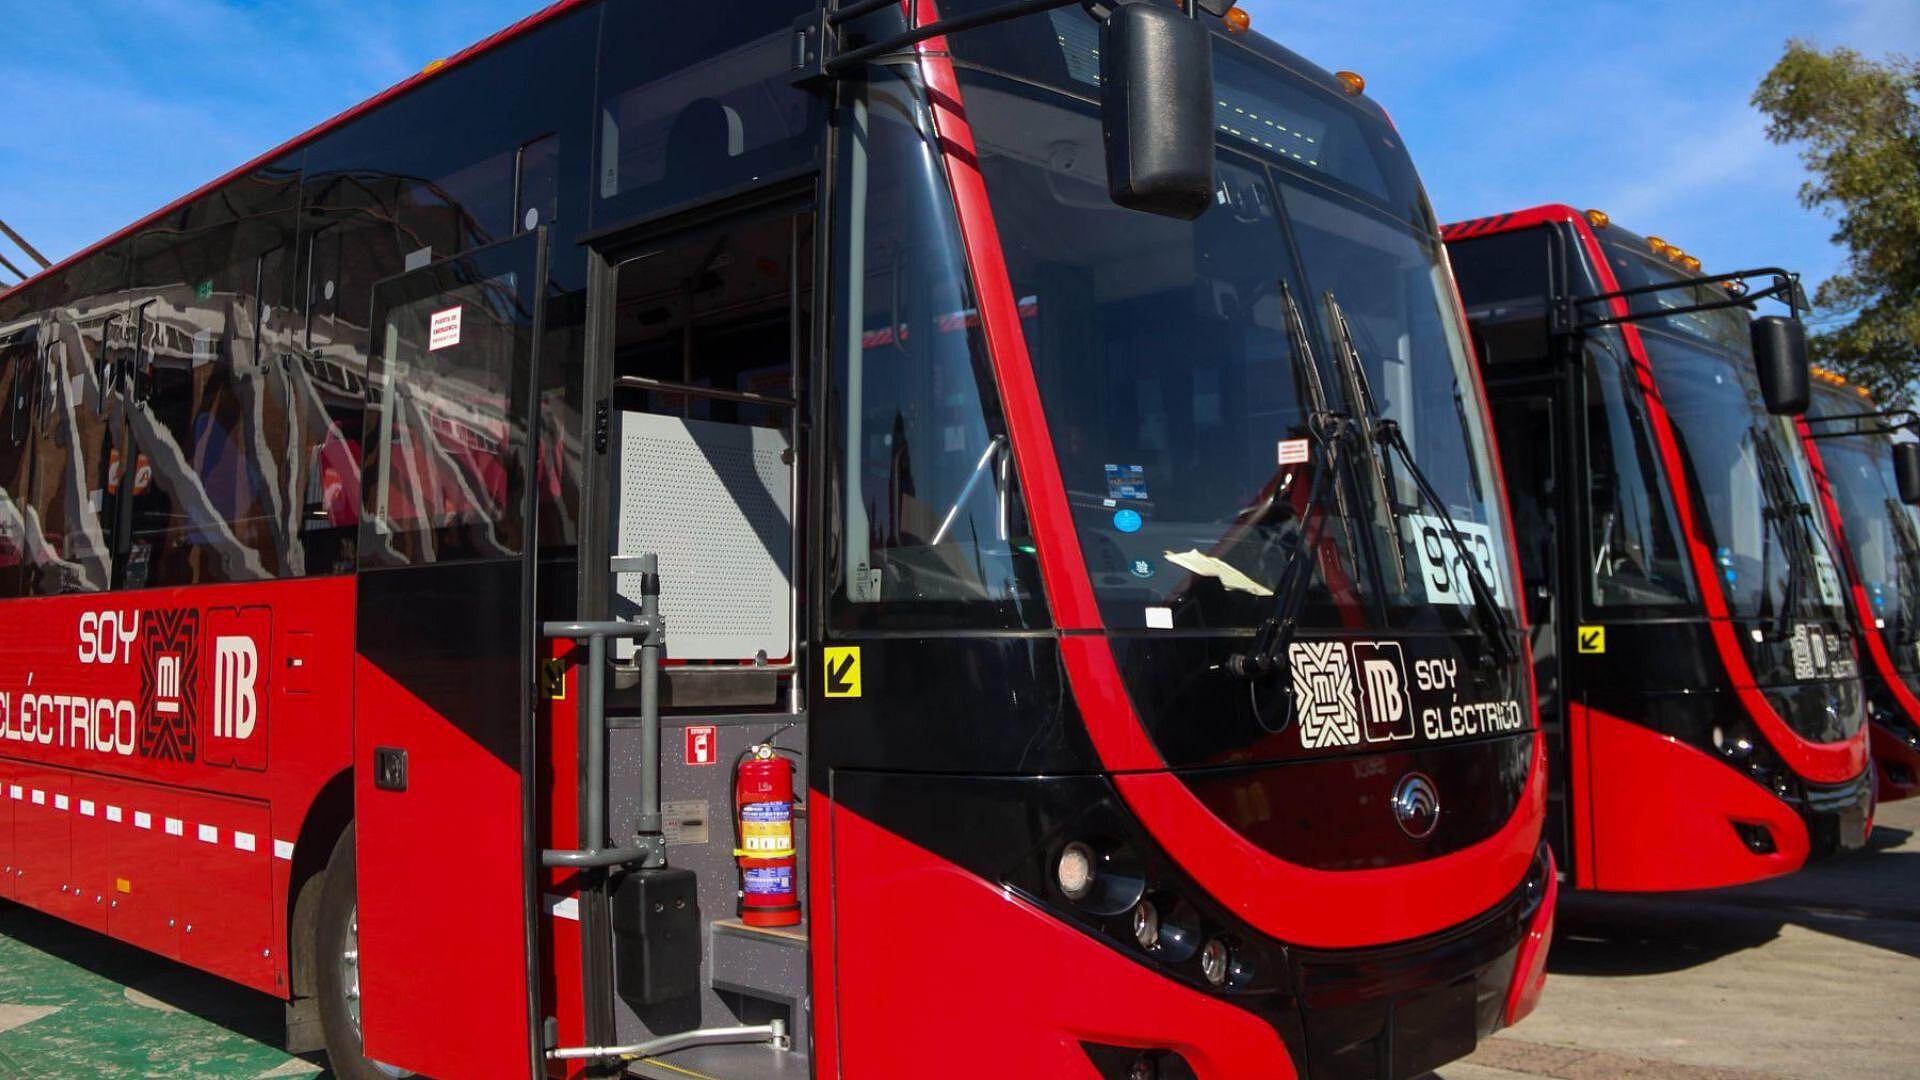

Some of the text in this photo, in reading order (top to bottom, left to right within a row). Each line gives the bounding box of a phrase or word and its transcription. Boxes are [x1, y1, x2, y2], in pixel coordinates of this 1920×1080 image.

[78, 610, 139, 664] SOY
[1415, 658, 1457, 691] SOY
[1423, 693, 1521, 740] ELÉCTRICO
